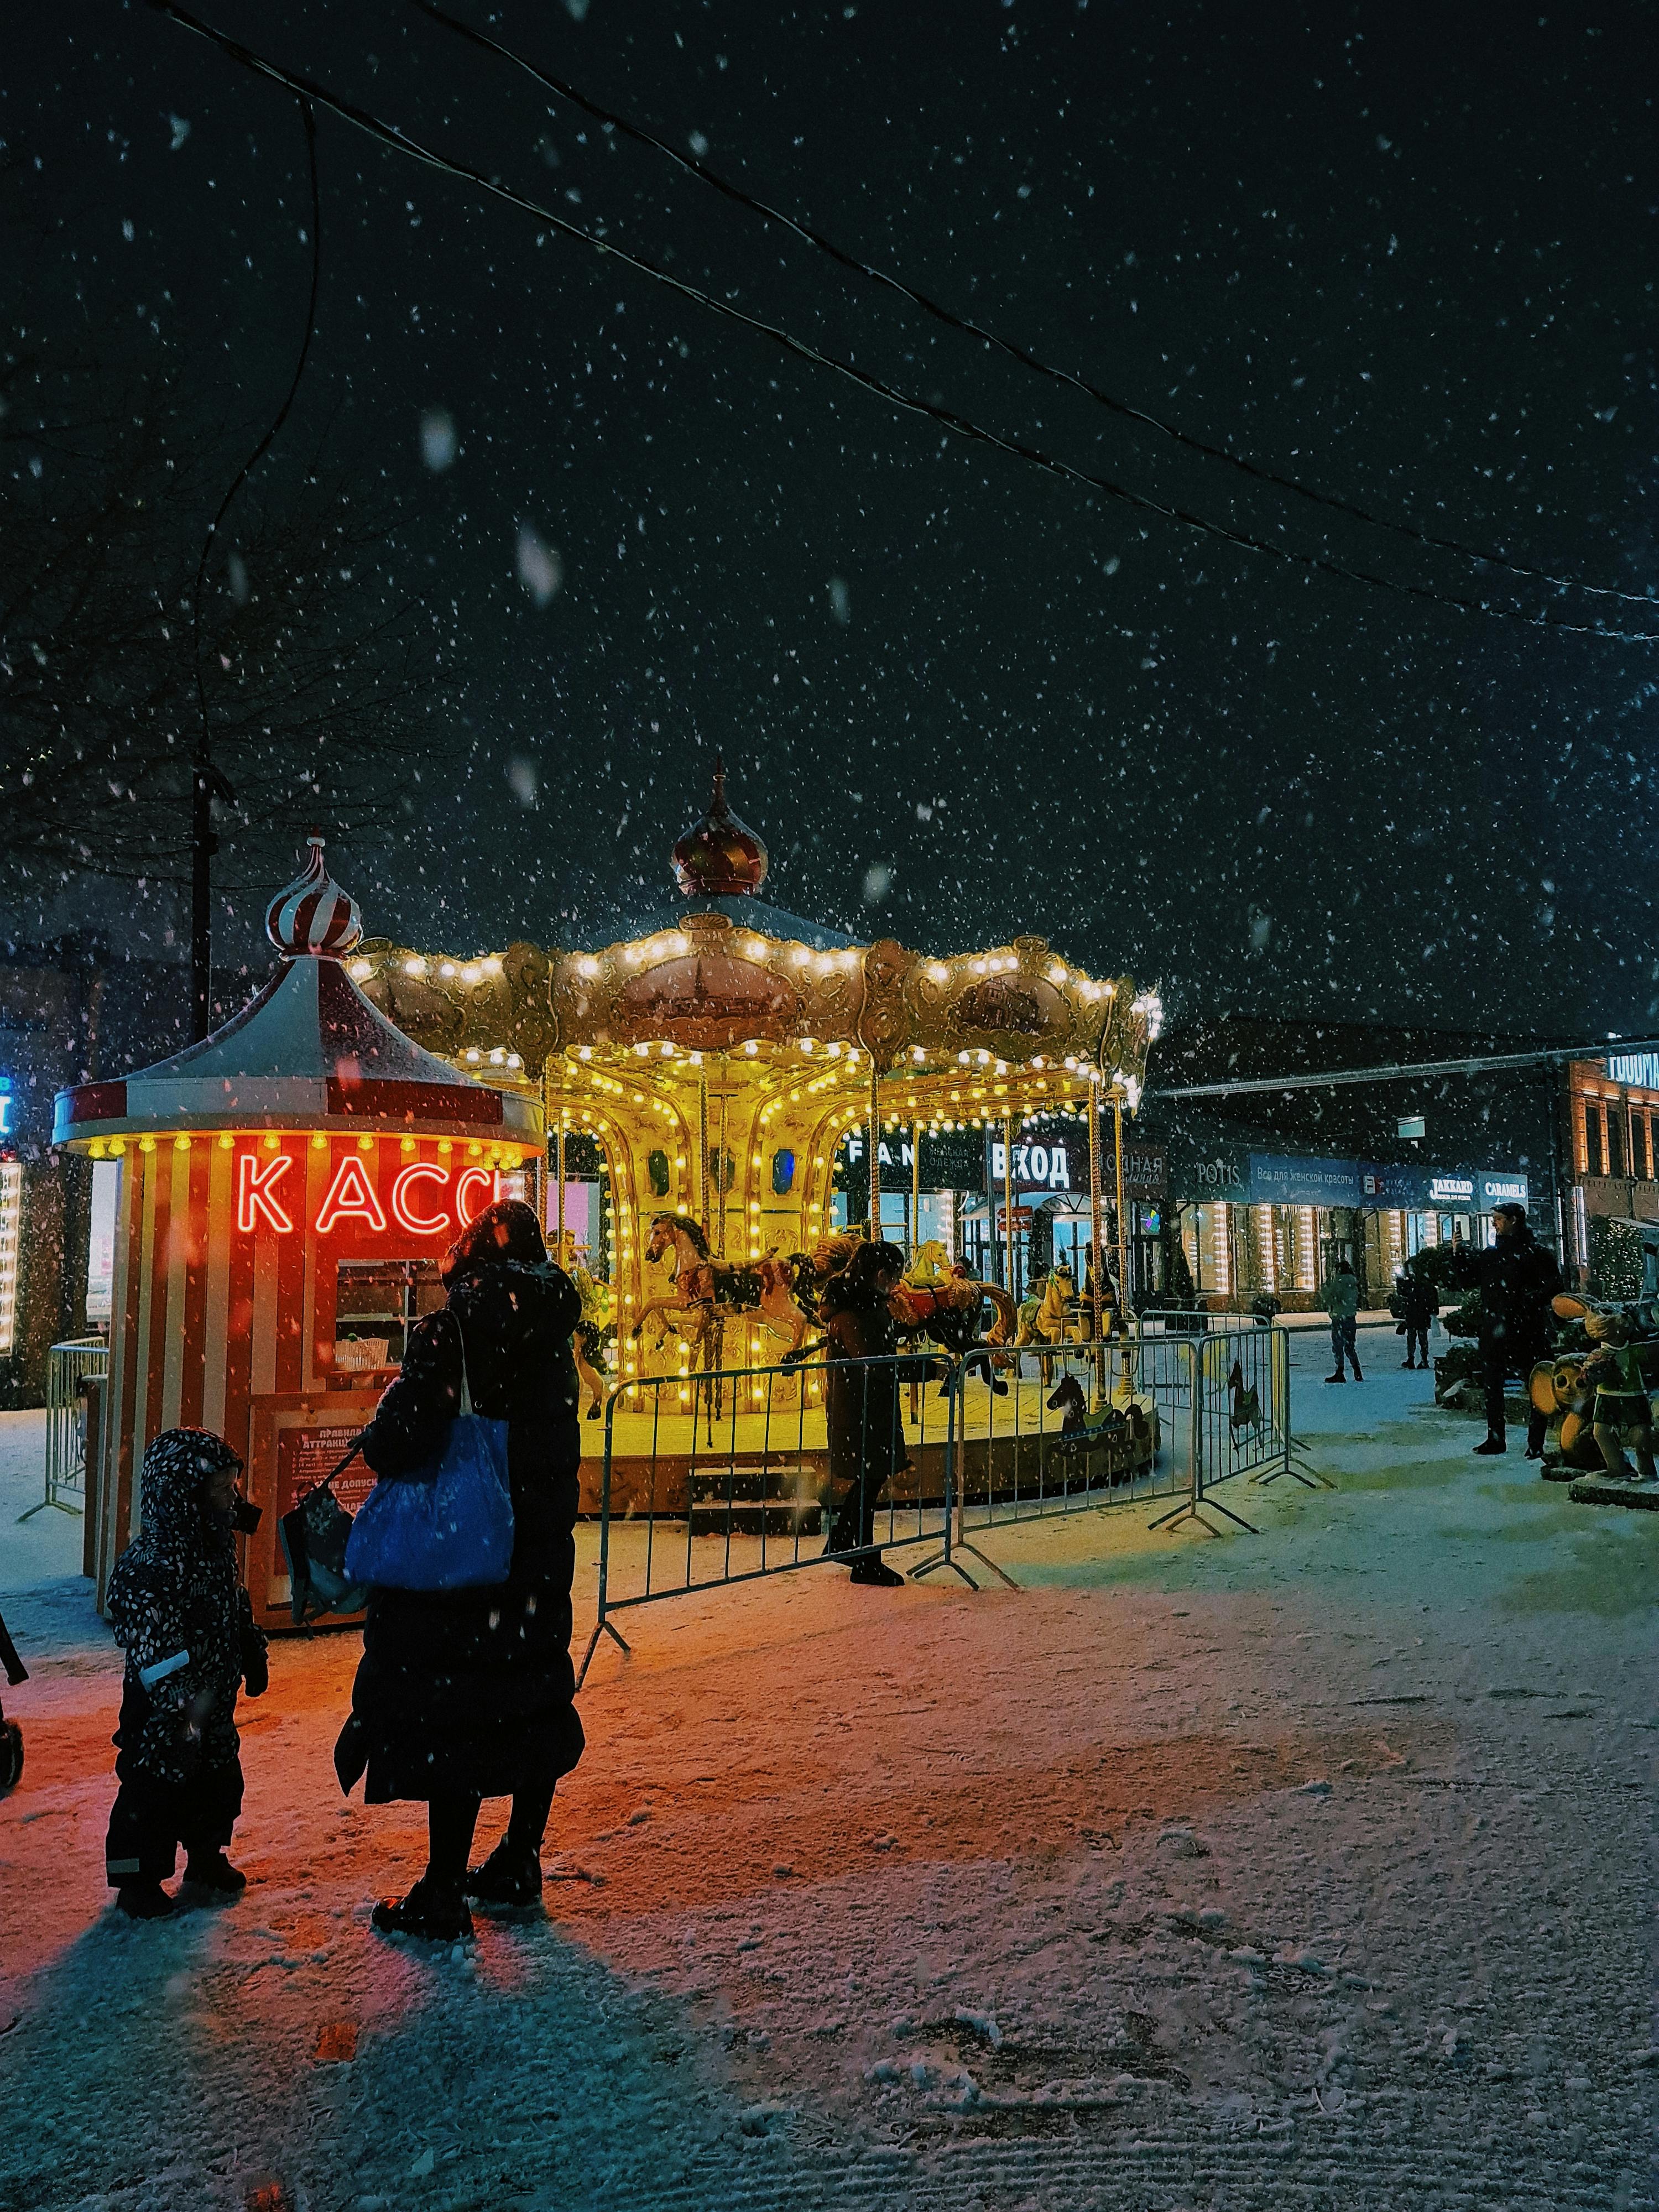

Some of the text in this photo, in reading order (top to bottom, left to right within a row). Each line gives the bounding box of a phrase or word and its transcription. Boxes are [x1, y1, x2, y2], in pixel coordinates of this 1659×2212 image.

[835, 1140, 915, 1166] FAN
[1099, 1153, 1163, 1175] ОДНАЯ
[1274, 1171, 1288, 1182] для
[1290, 1171, 1323, 1182] женской
[1325, 1173, 1354, 1185] красоты
[238, 1154, 500, 1234] КАСС
[1429, 1178, 1473, 1200] JAKKARD
[1485, 1182, 1526, 1198] CARAMELS
[320, 1428, 362, 1438] ПРАВИЛА
[341, 1478, 378, 1490] ДОПУСК
